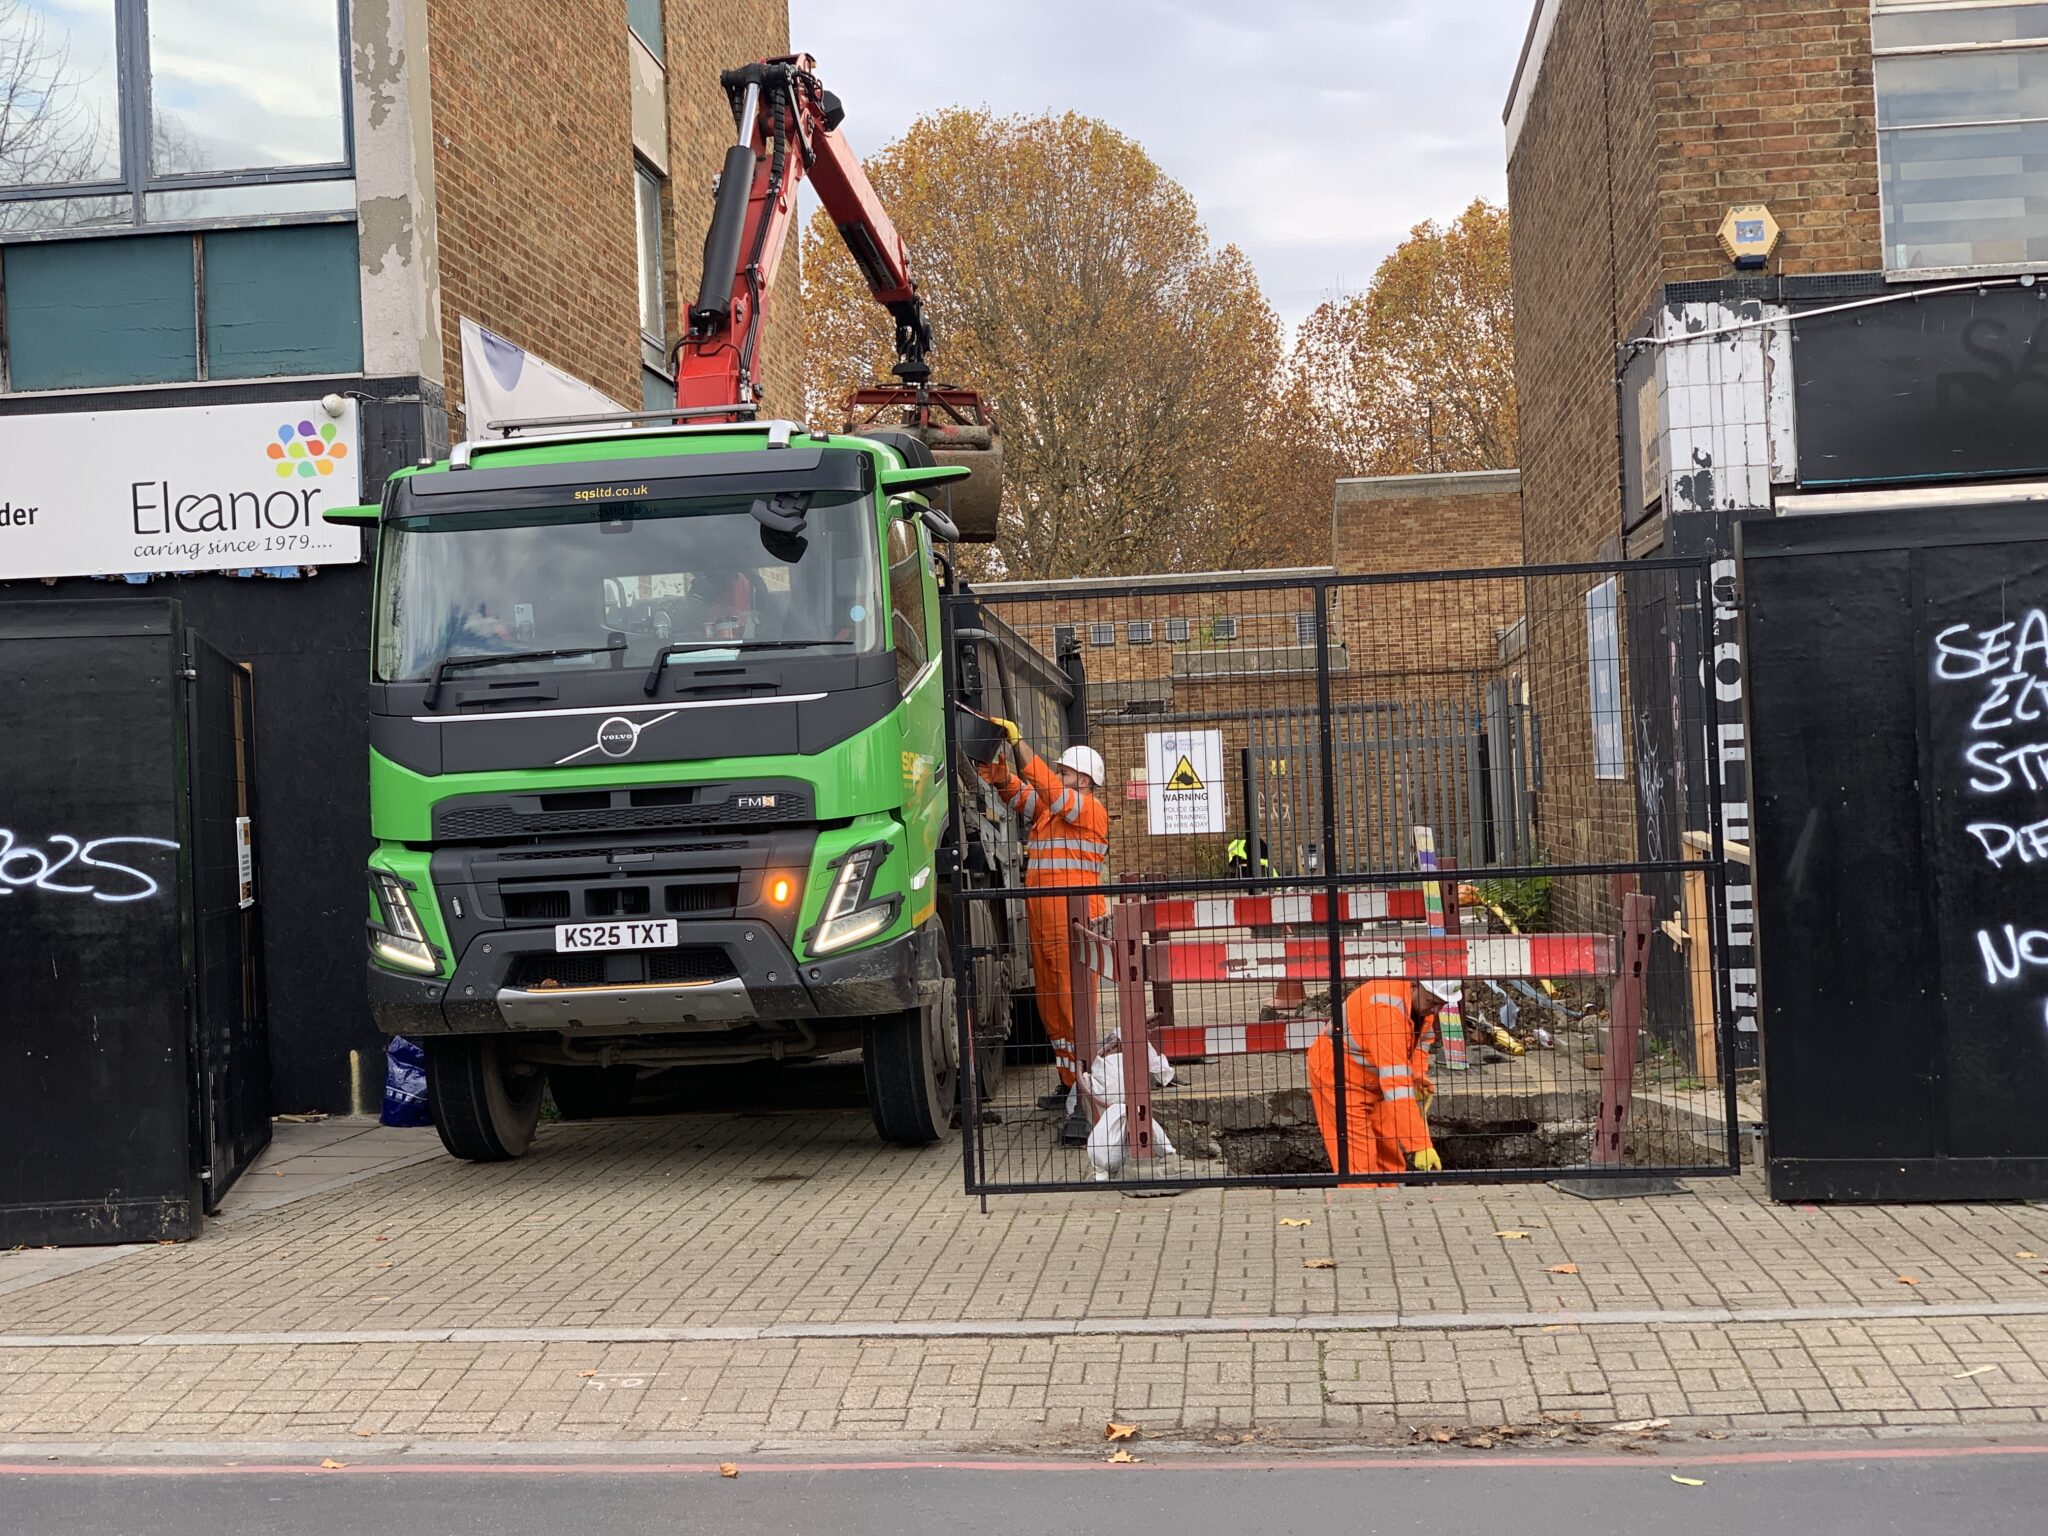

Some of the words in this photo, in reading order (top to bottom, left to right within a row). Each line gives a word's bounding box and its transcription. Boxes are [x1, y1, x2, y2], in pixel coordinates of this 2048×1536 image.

[574, 485, 648, 501] sqsltd.co.uk
[132, 480, 322, 535] Eleanor
[133, 538, 201, 560] caring
[207, 537, 260, 555] since
[602, 733, 633, 741] VOLVO
[738, 796, 775, 808] FMX
[1163, 792, 1208, 801] WARNING
[565, 926, 621, 948] KS25
[627, 923, 668, 944] TXT
